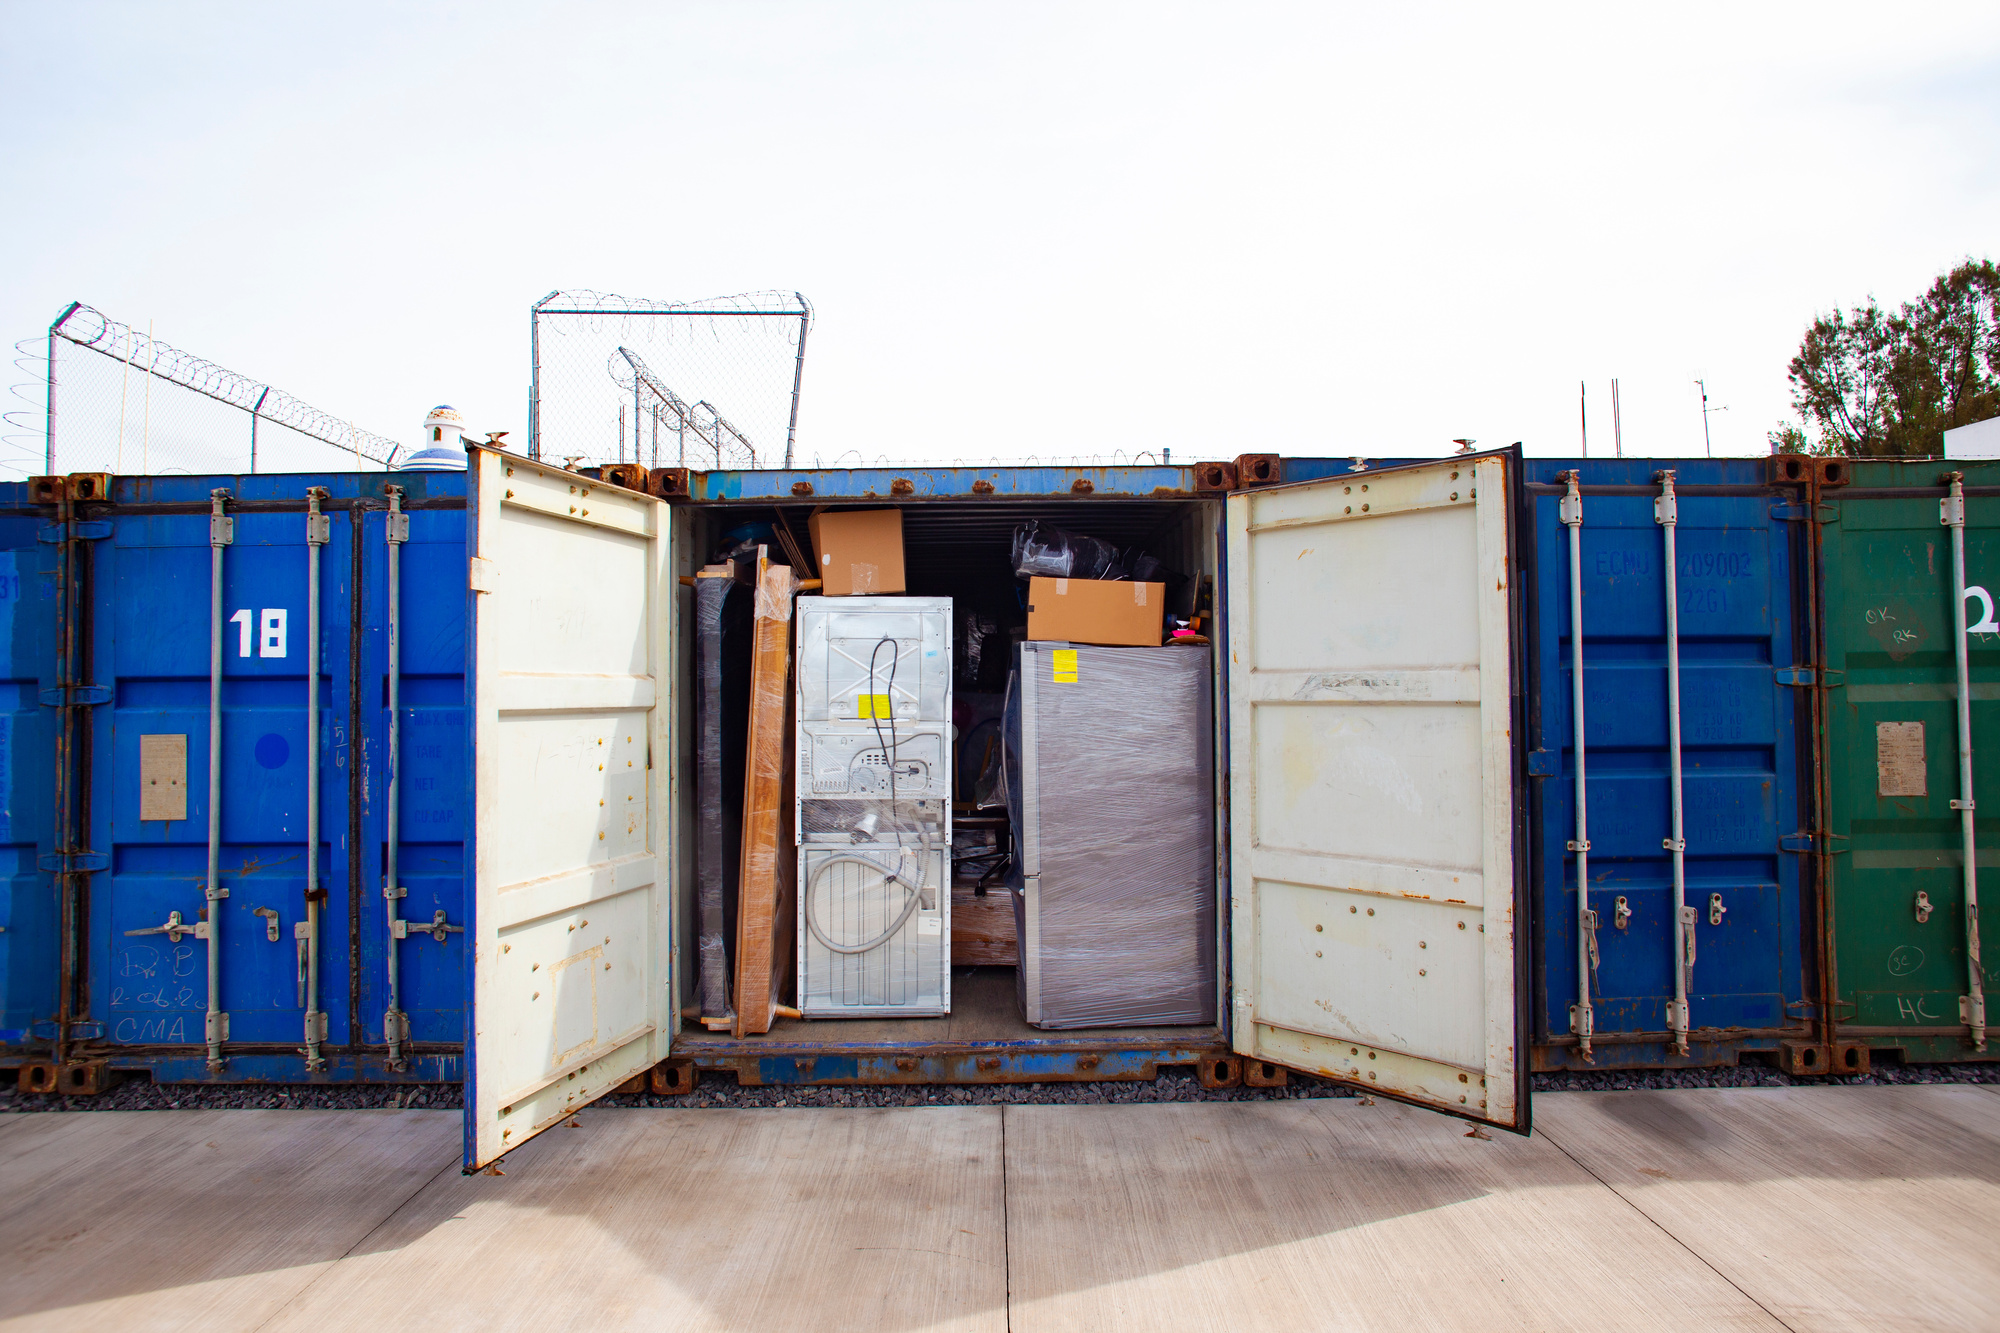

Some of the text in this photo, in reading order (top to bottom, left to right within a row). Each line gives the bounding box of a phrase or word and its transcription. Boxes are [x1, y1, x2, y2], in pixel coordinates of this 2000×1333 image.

[1595, 550, 1649, 577] ECMU
[1964, 585, 1999, 633] 2
[229, 608, 287, 658] 18
[414, 777, 434, 791] NET
[1897, 997, 1940, 1024] HC
[115, 1017, 187, 1042] CMA
